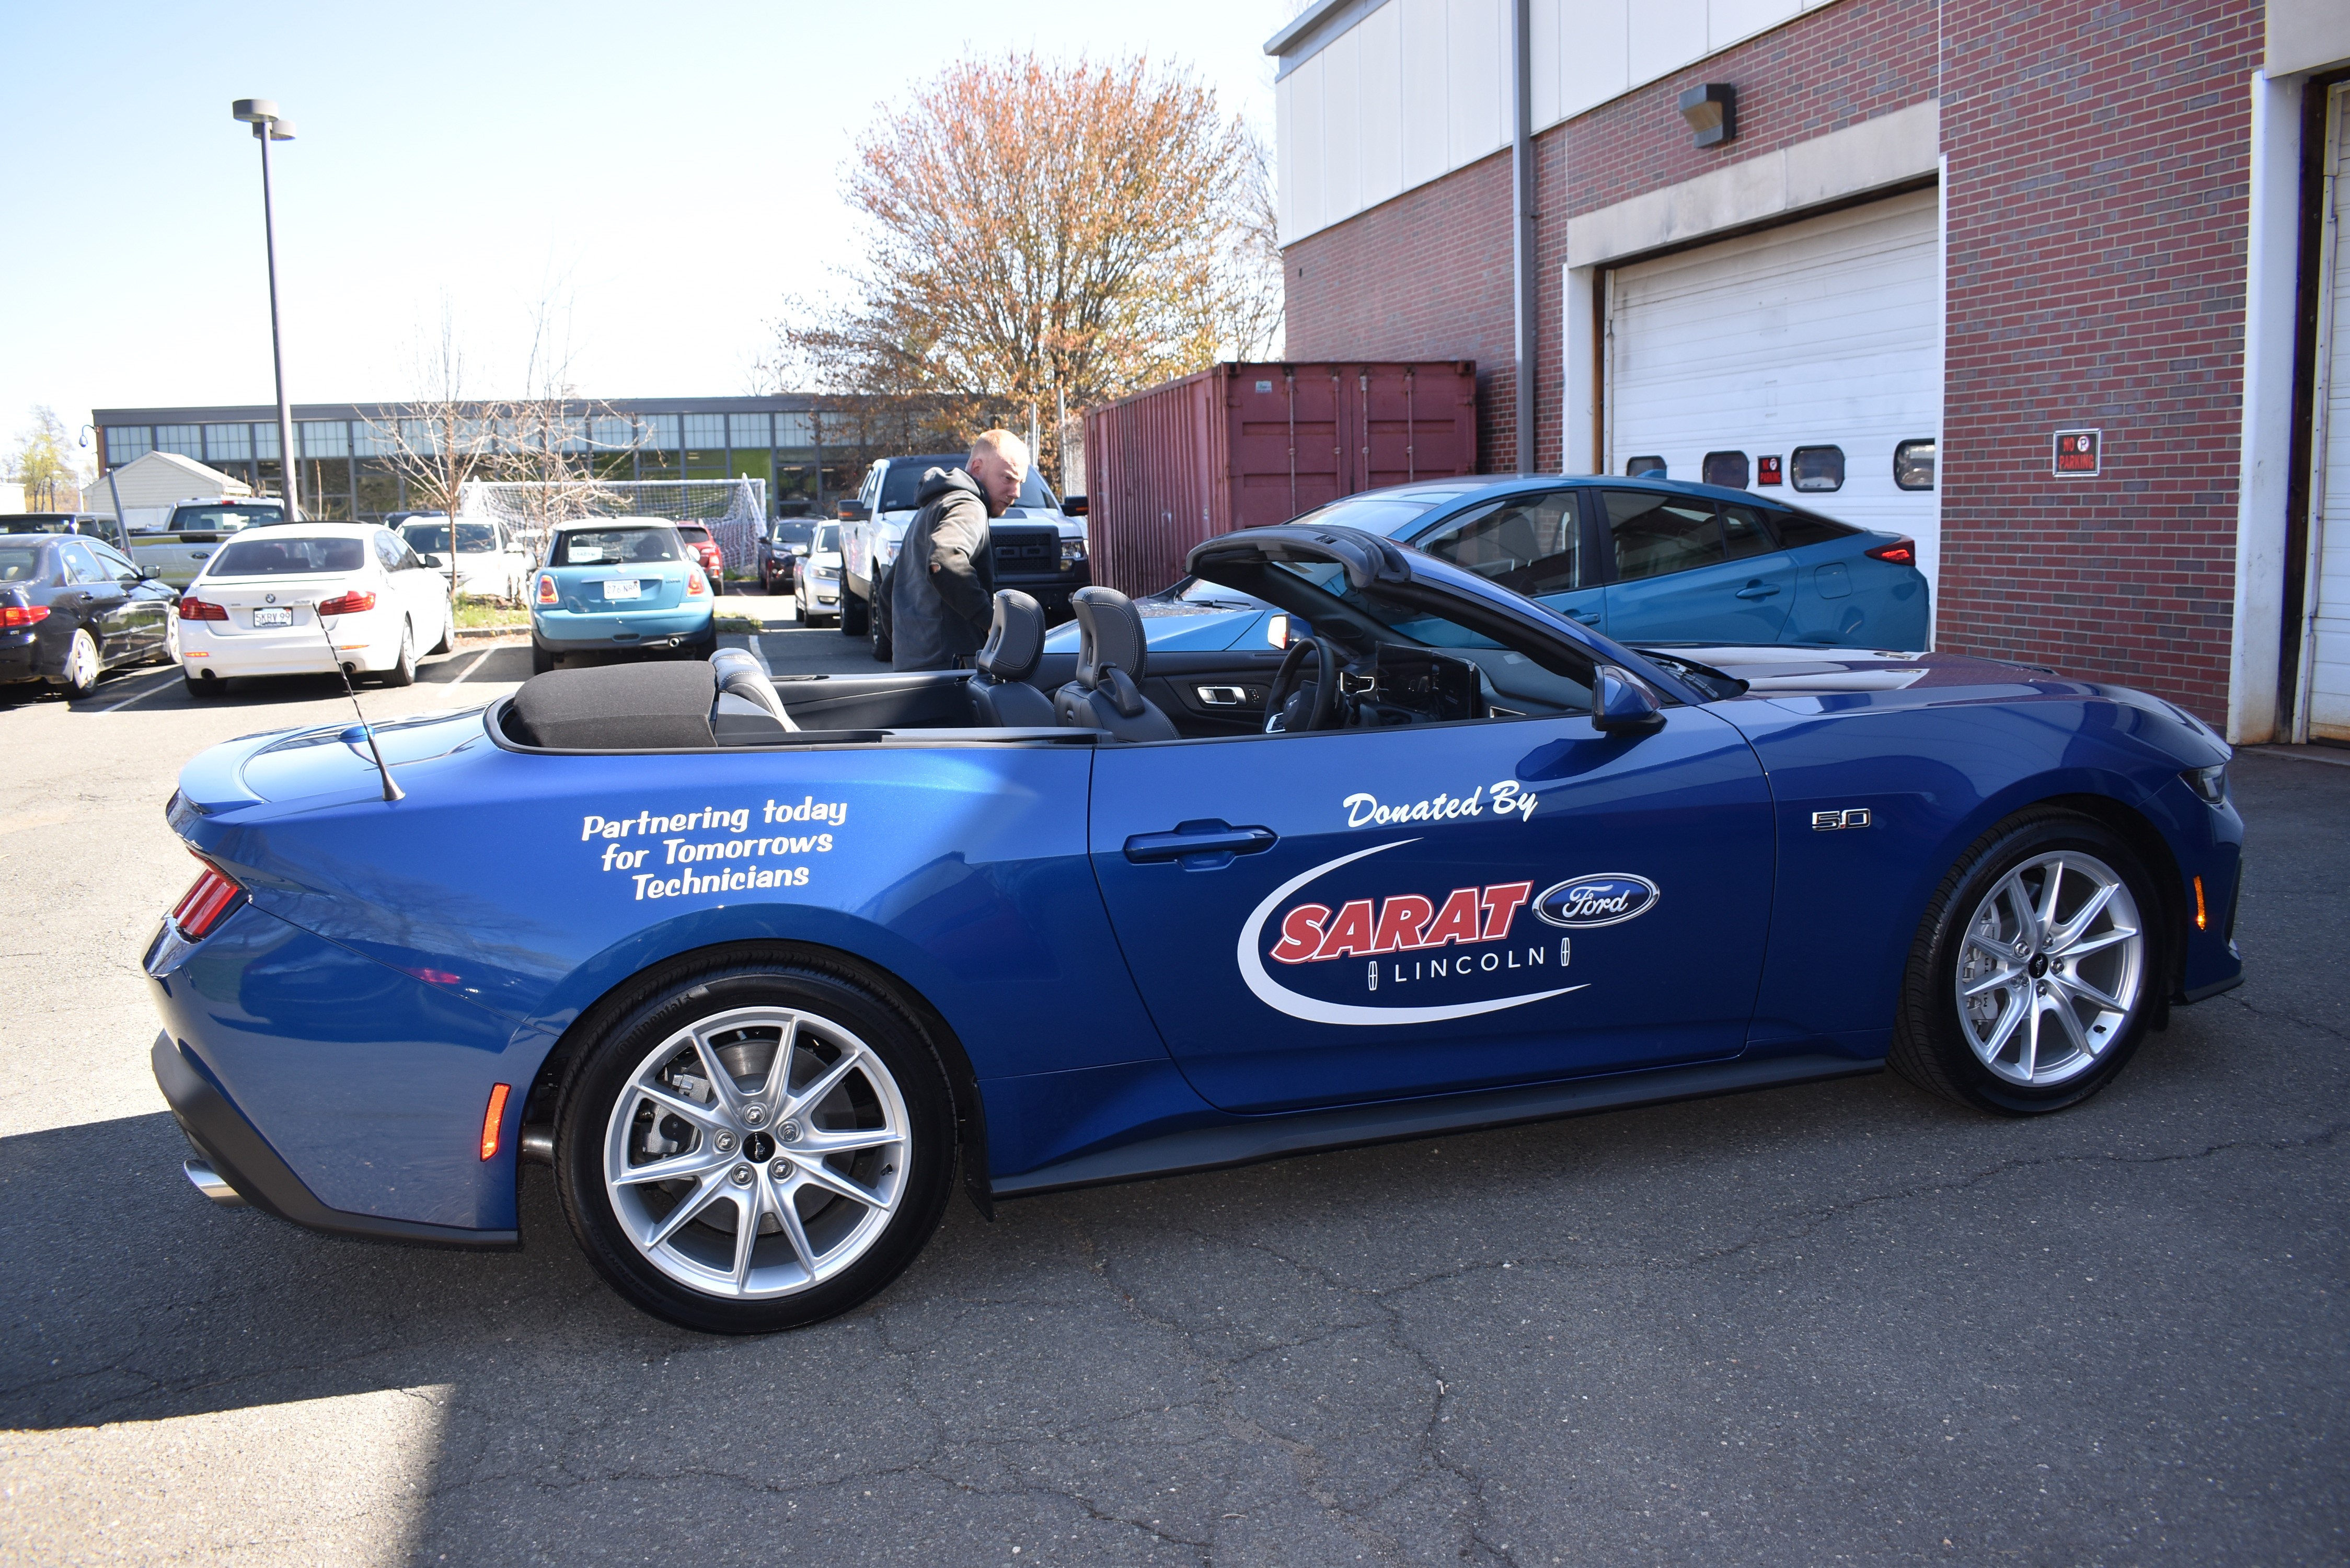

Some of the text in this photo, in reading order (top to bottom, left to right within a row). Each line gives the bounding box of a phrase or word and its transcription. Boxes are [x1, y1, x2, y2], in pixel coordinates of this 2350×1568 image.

[2059, 454, 2094, 469] PARKING
[2063, 437, 2075, 452] NO
[1760, 471, 1781, 483] PARKING
[581, 795, 848, 841] Partnering today
[1343, 780, 1538, 828] Donated By
[1812, 808, 1870, 831] 5.0
[601, 833, 833, 871] for Tomorrows
[632, 865, 809, 901] Technicians
[1562, 884, 1630, 917] Ford
[1269, 880, 1534, 964] SARAT
[1395, 947, 1544, 982] LINCOLN
